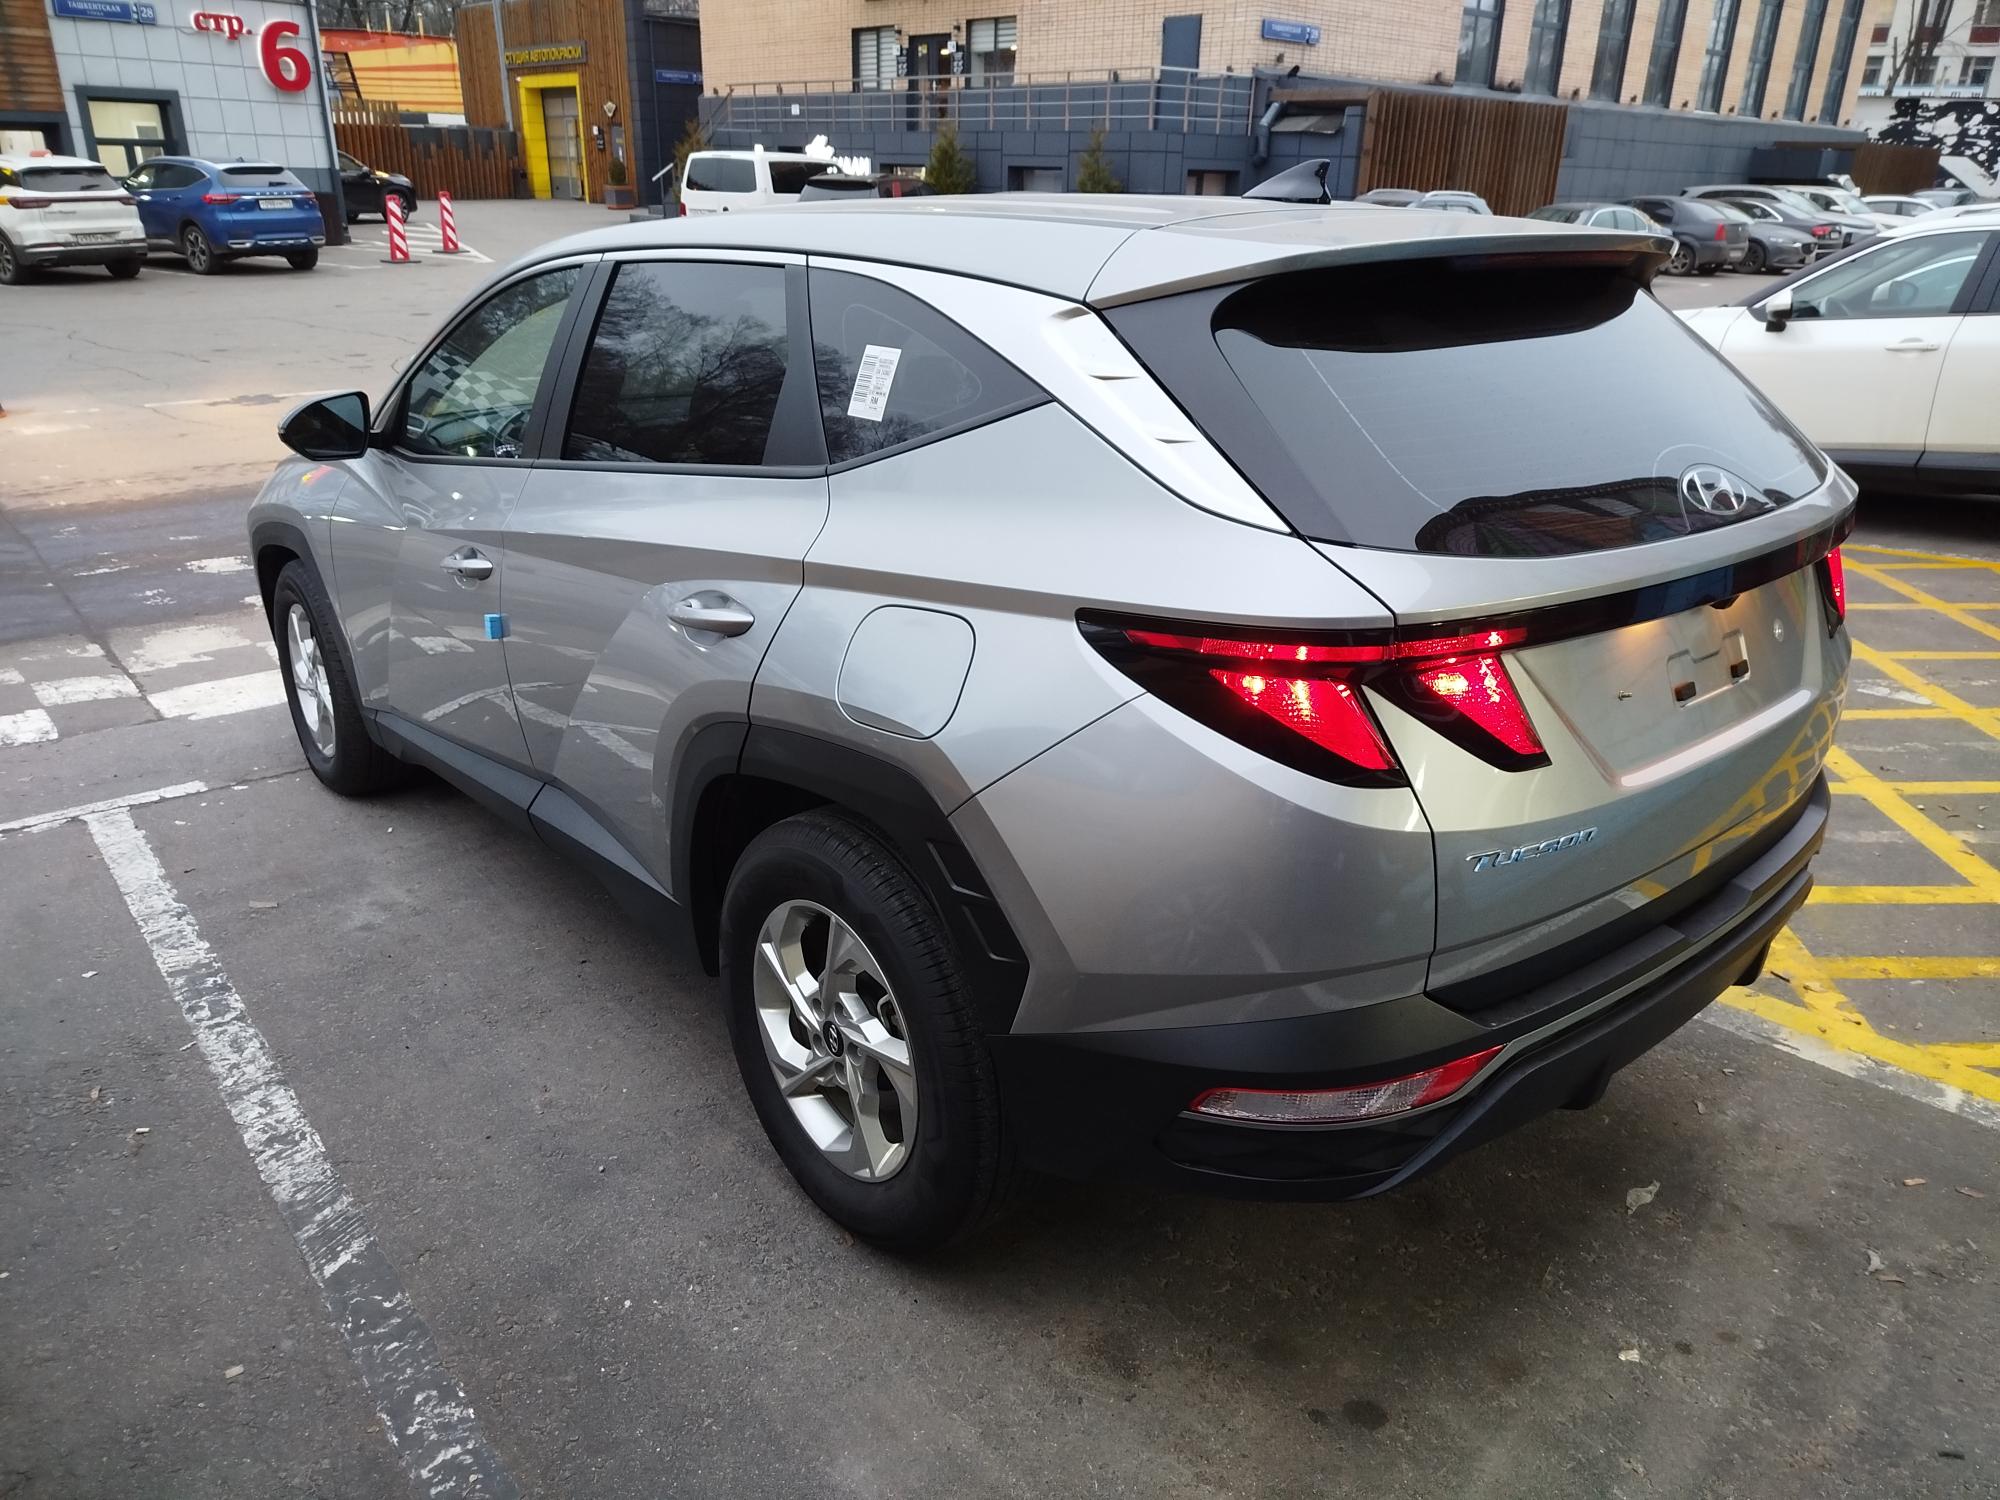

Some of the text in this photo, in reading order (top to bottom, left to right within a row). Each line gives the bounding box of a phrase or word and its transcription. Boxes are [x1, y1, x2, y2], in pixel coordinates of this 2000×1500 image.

[67, 0, 121, 12] ТАШКЕНТСКАЯ
[140, 7, 154, 18] 28
[193, 12, 252, 40] стр.
[259, 20, 311, 92] 6
[1465, 826, 1598, 872] TUCSON
